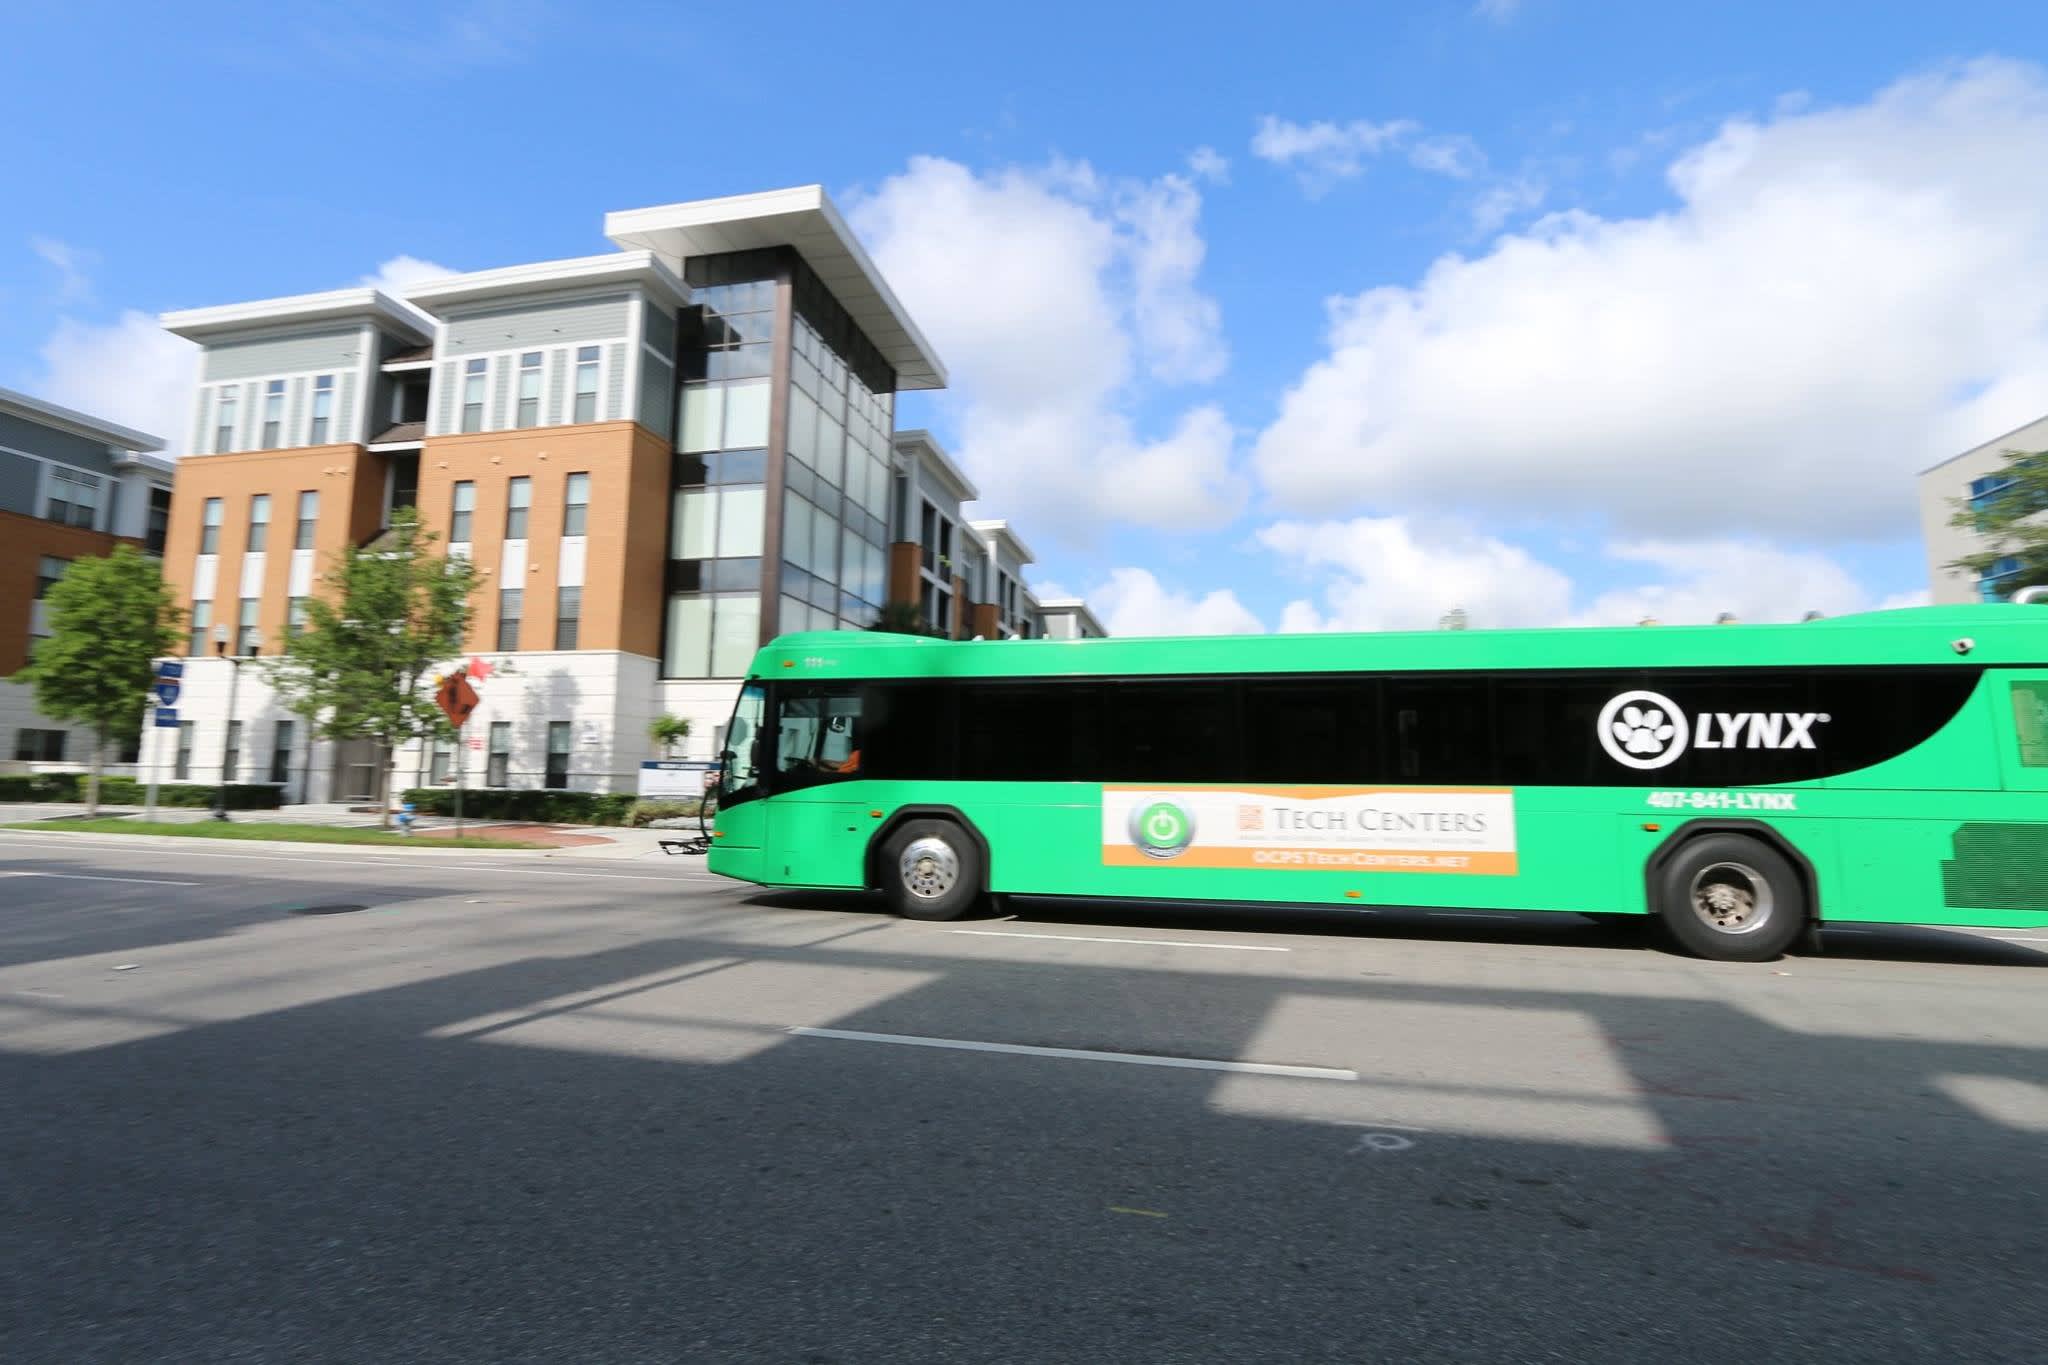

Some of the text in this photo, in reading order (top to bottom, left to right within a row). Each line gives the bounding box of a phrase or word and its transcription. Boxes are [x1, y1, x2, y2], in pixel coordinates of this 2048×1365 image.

[1694, 713, 1817, 749] LYNX
[1271, 808, 1488, 832] TECH CENTERS
